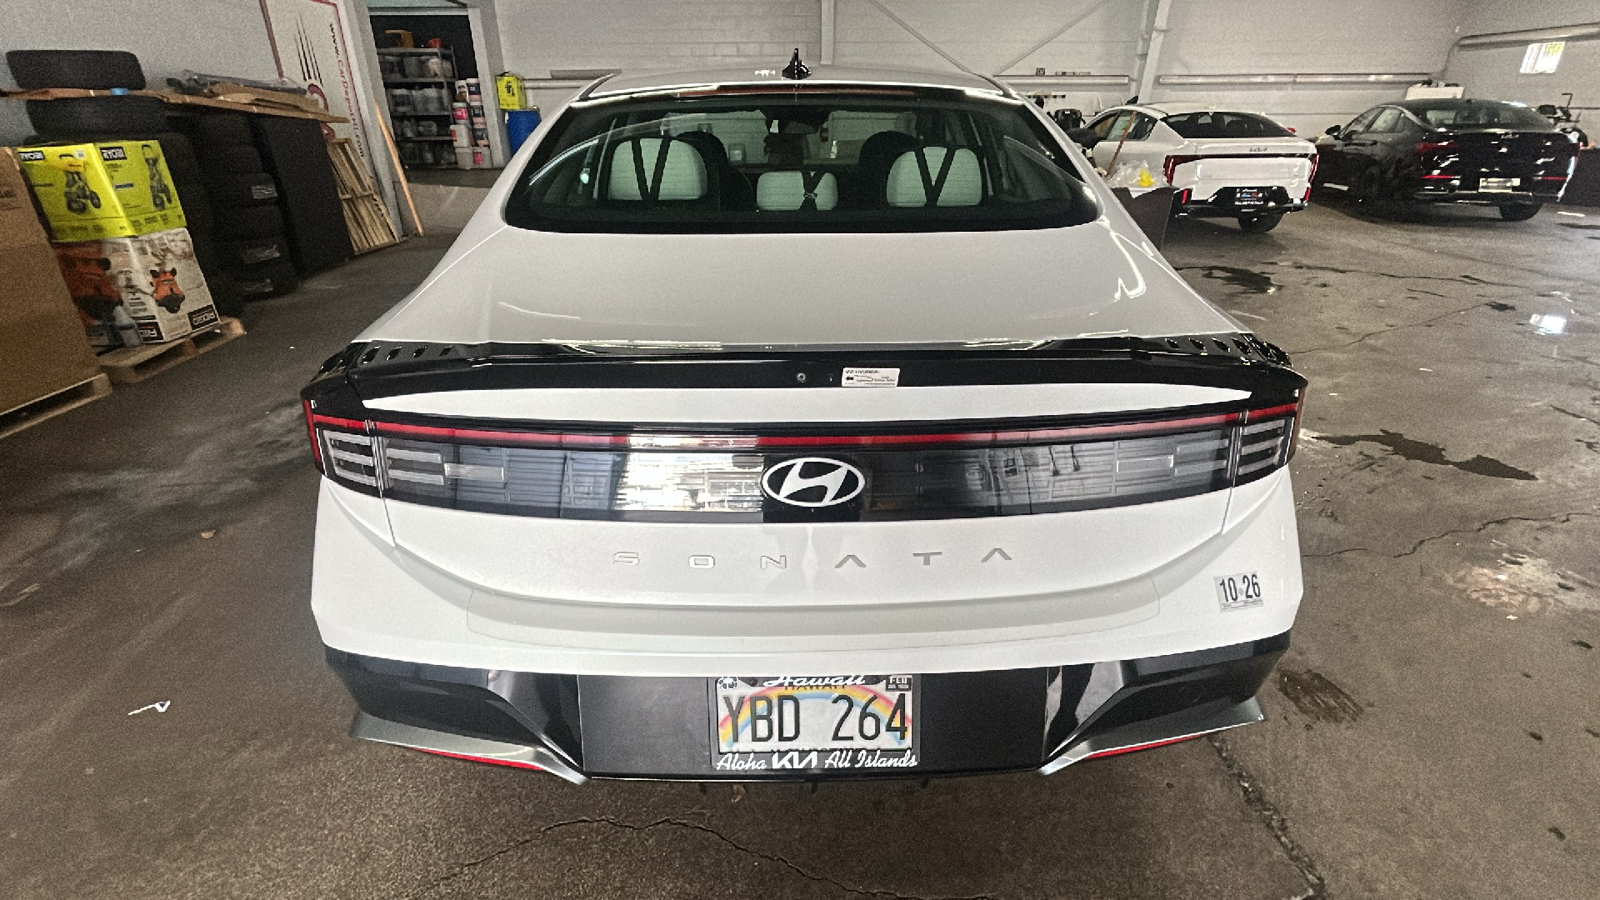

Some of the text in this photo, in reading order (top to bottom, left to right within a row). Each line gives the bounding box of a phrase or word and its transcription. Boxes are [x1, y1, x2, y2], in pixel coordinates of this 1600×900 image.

[613, 548, 1012, 569] SONATA
[763, 675, 865, 687] Hawaii
[723, 693, 908, 742] YBD 264
[716, 749, 918, 770] Aloha KIA All Islands
